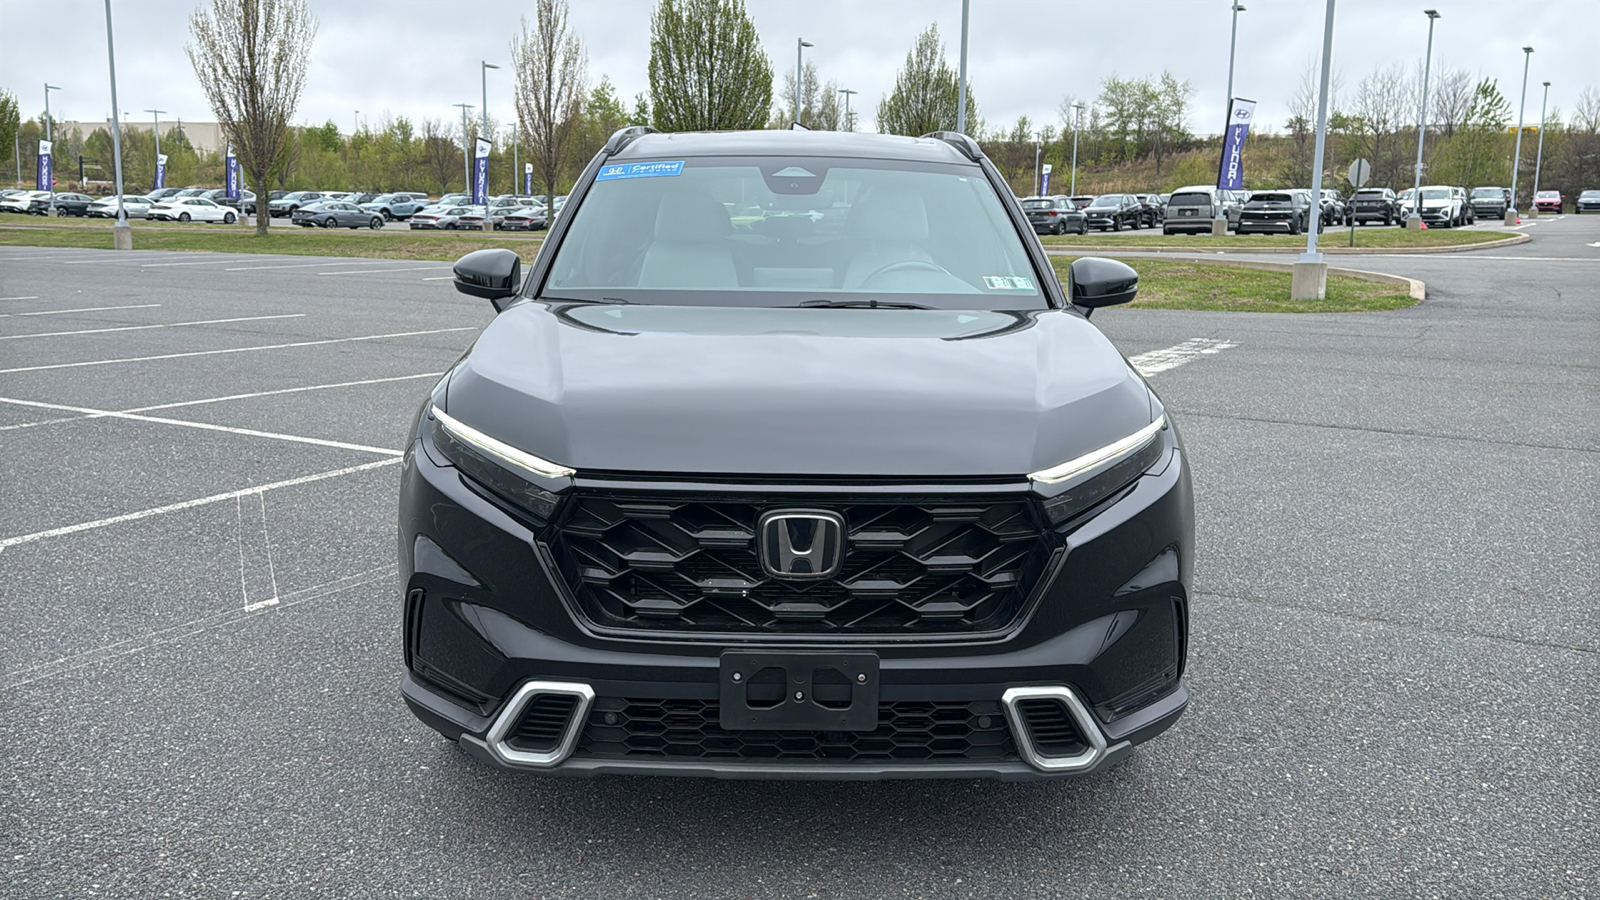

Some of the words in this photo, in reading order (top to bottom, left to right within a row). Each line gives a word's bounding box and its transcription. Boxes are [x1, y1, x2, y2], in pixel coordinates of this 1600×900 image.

[632, 163, 679, 171] Certified
[1227, 127, 1242, 187] HYUNDAI
[478, 159, 486, 203] HYUNDAI
